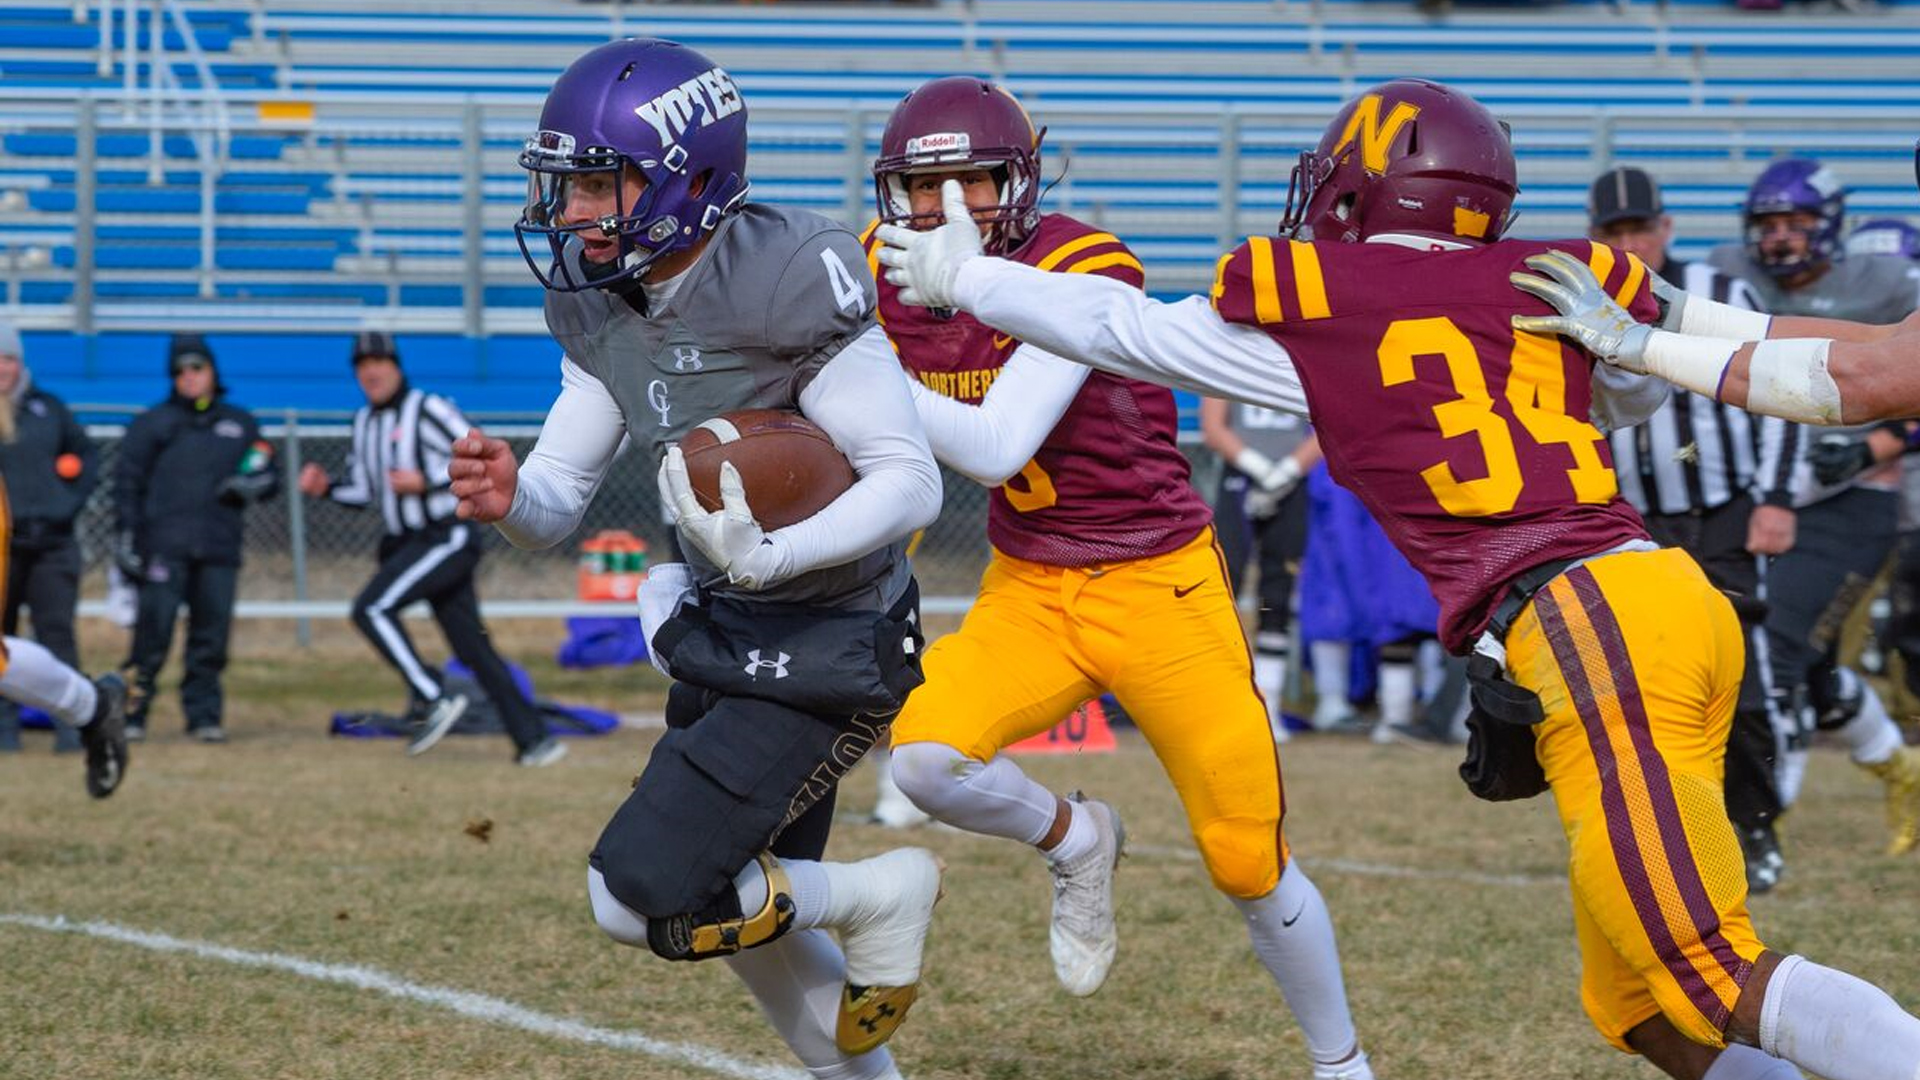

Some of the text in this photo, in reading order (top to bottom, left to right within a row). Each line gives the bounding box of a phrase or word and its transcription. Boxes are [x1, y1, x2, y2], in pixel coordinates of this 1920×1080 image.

[634, 67, 742, 148] YOTES
[921, 135, 956, 148] Riddell
[1332, 94, 1421, 175] N
[820, 247, 868, 316] 4
[1377, 316, 1618, 517] 34
